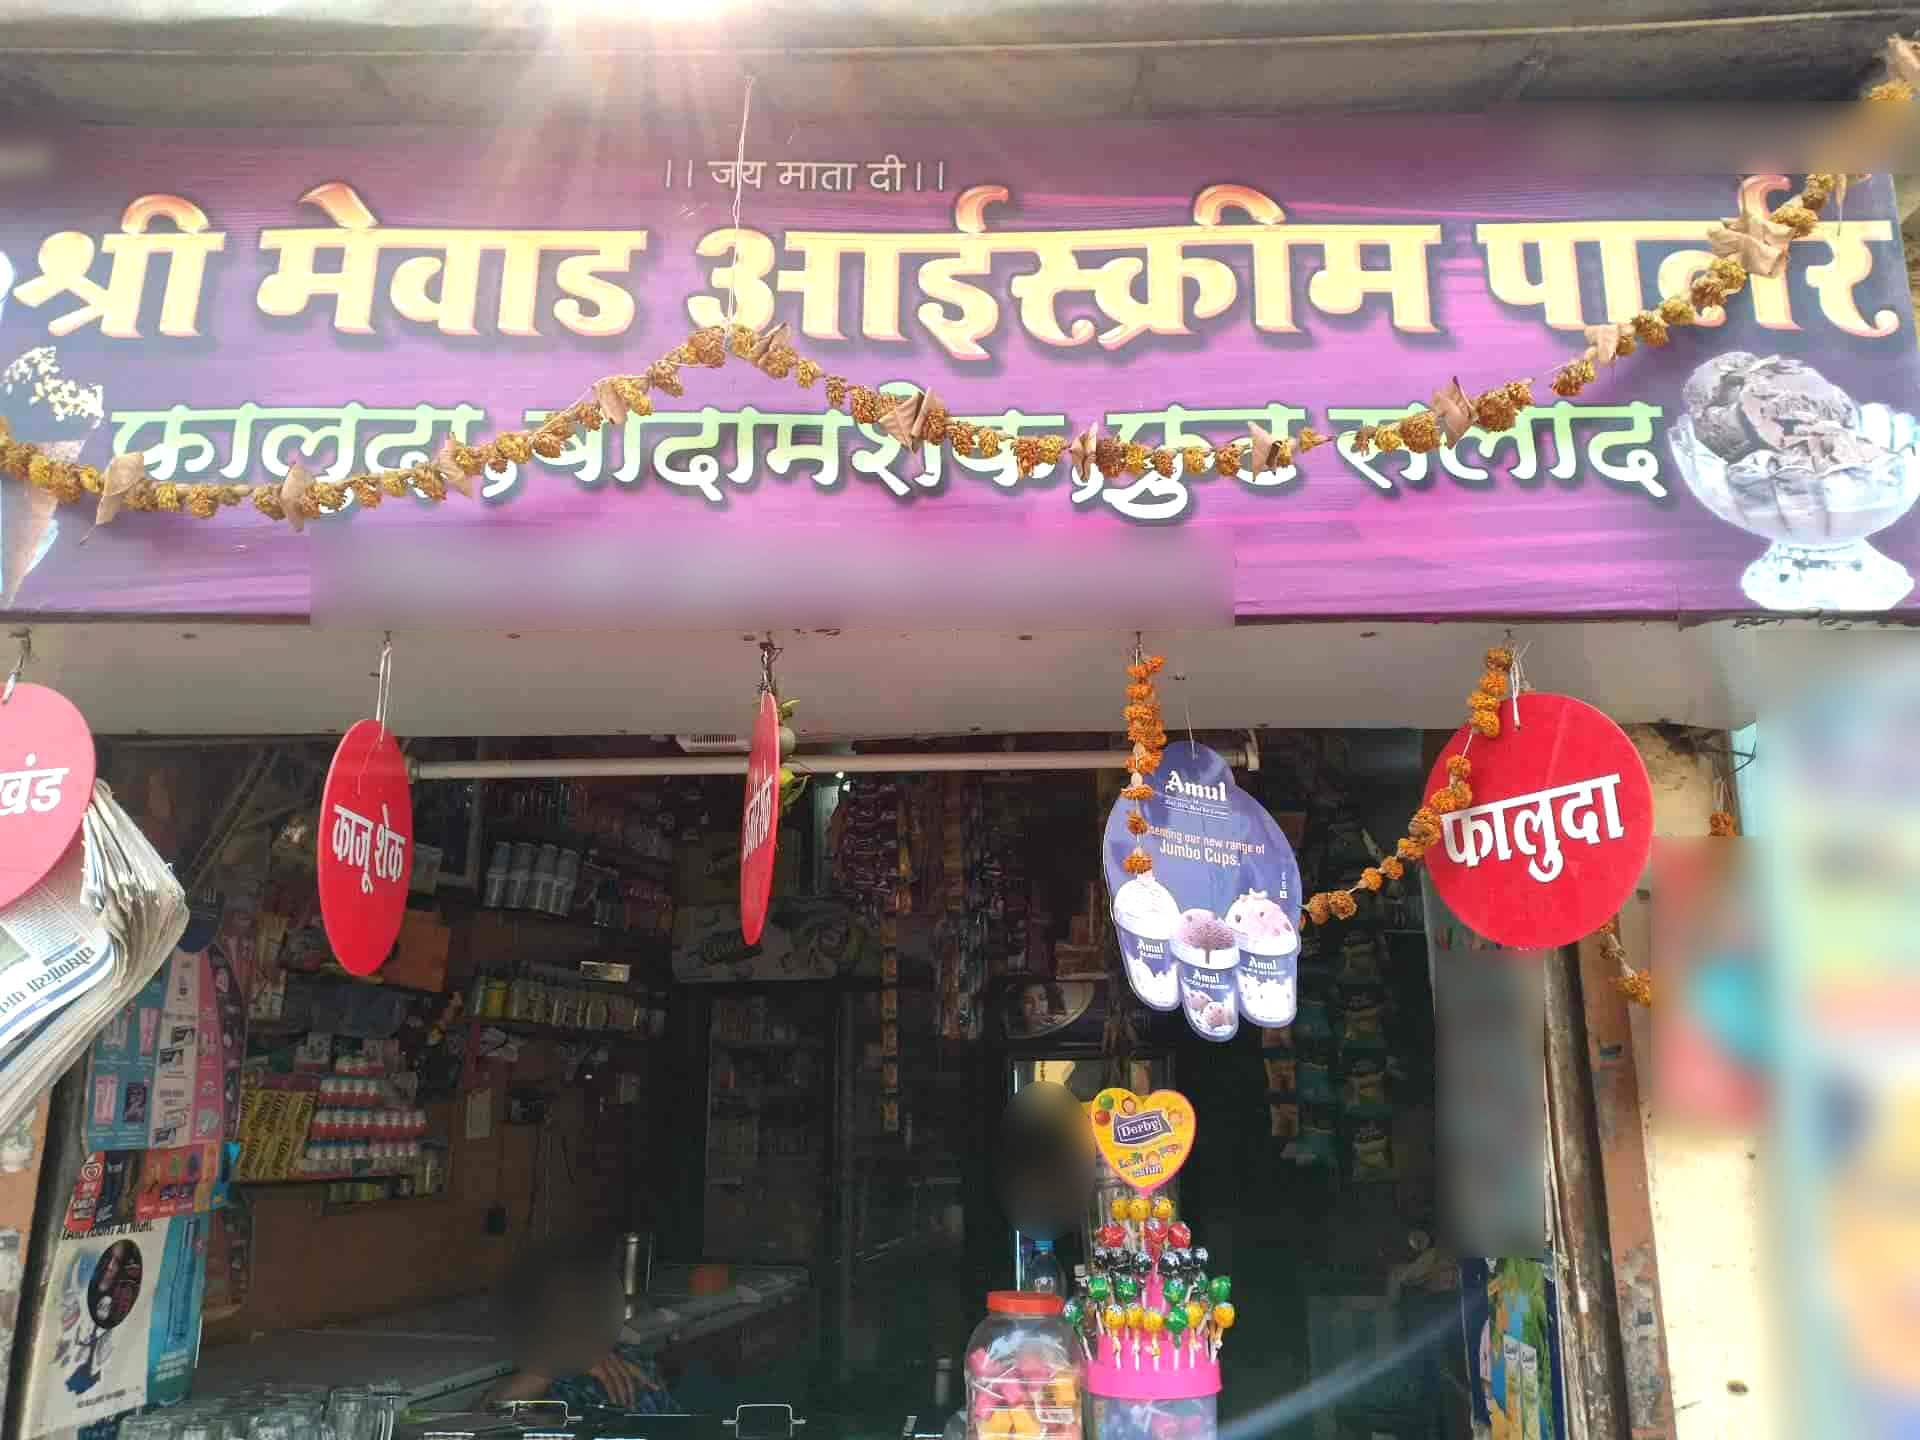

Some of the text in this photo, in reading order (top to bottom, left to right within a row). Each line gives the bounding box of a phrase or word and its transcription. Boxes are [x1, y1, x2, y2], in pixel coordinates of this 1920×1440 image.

[707, 160, 767, 189] जय
[775, 161, 858, 191] माता
[13, 193, 226, 337] श्री
[256, 181, 648, 336] मेवाड
[687, 184, 1441, 358] आईस्क्रीम
[1165, 770, 1226, 802] Amul
[1439, 772, 1624, 883] फालुदा
[333, 803, 406, 894] काजू शेक
[1160, 839, 1241, 868] Jumbo Cups.
[1203, 836, 1223, 848] new
[1225, 840, 1255, 855] range
[1137, 938, 1164, 954] Amul
[1193, 969, 1220, 984] Amul
[1249, 956, 1277, 970] Amul
[1121, 1118, 1160, 1138] Derby
